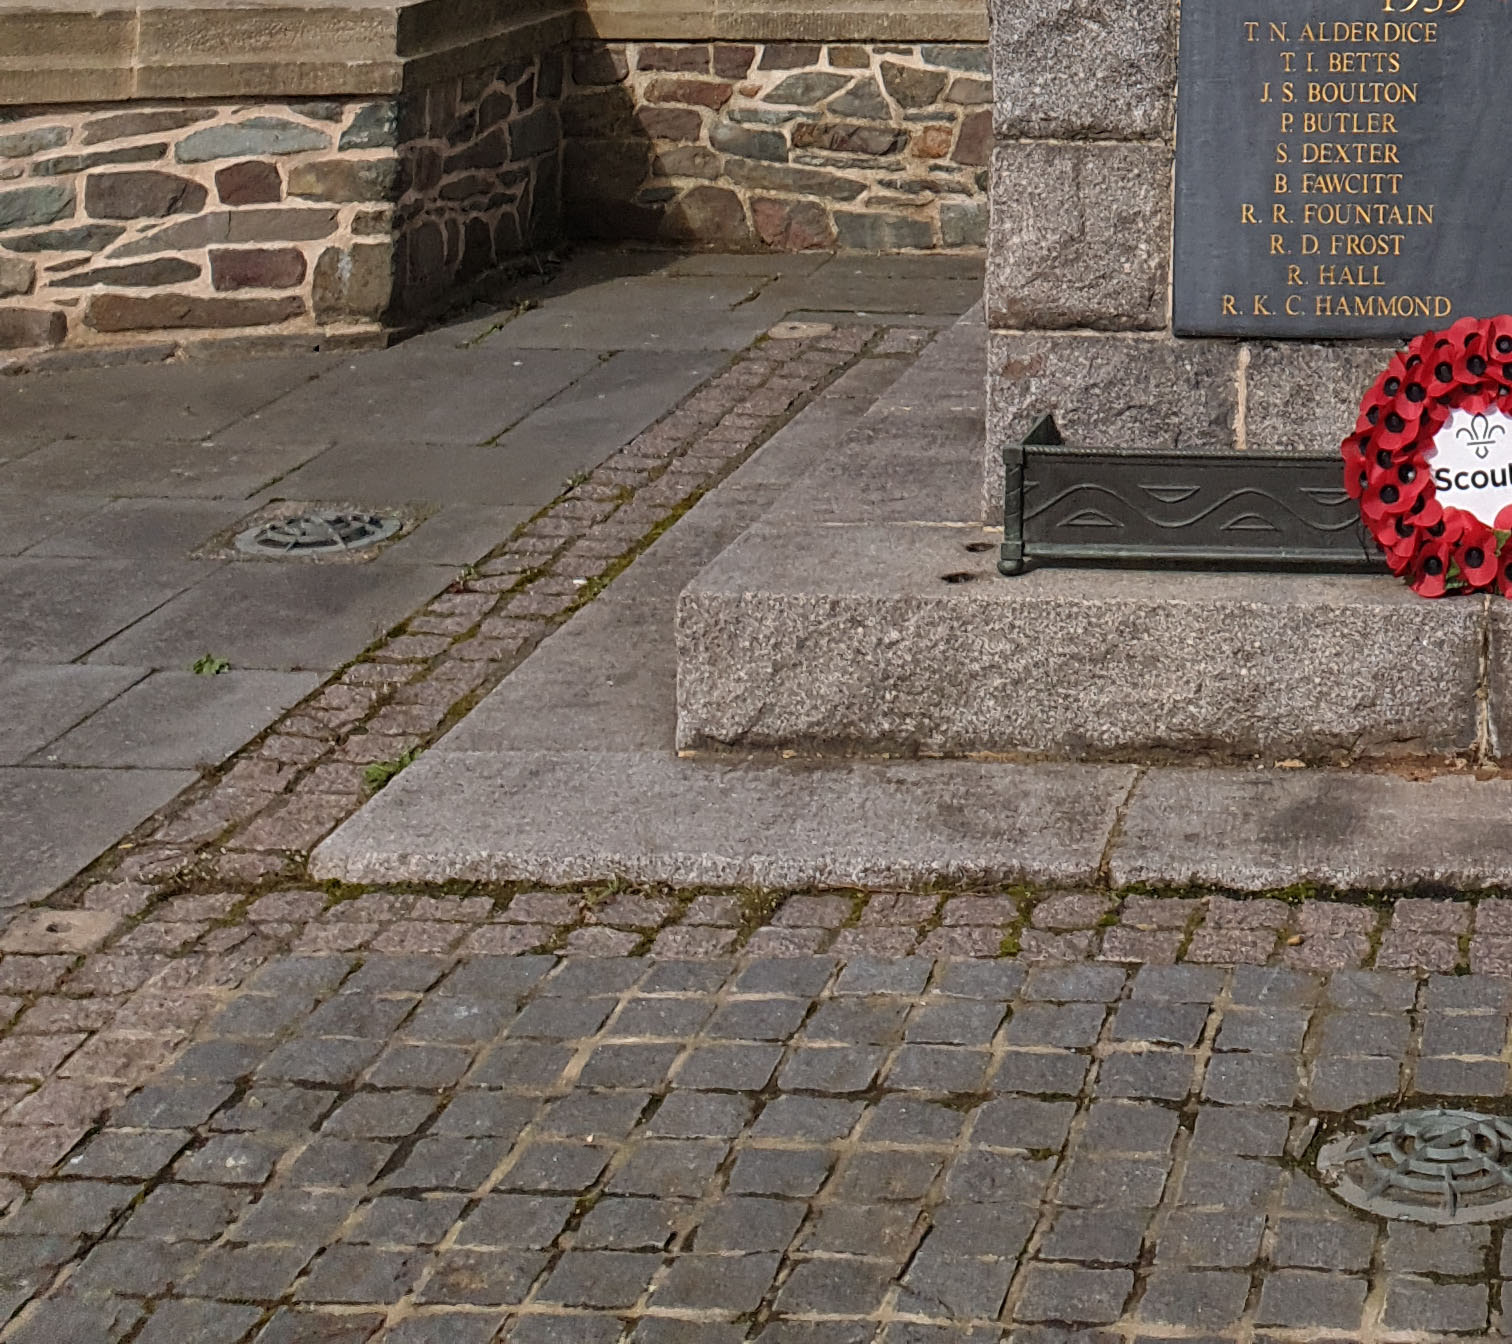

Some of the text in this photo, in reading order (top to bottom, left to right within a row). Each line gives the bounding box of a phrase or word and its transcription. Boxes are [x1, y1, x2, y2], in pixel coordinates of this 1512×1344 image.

[1245, 22, 1438, 43] T. N. ALDERDICE
[1280, 52, 1400, 73] T. I. BETTS
[1261, 82, 1418, 104] J. S. BOULTON
[1281, 112, 1399, 135] P. BUTLER
[1276, 143, 1400, 165] S. DEXTER
[1274, 174, 1403, 195] B. FAWCITT
[1241, 204, 1434, 226] R. R. FOUNTAIN
[1270, 235, 1405, 256] R. D. FROST
[1288, 265, 1386, 286] R. HALL
[1223, 295, 1452, 317] R. K. C. HAMMOND
